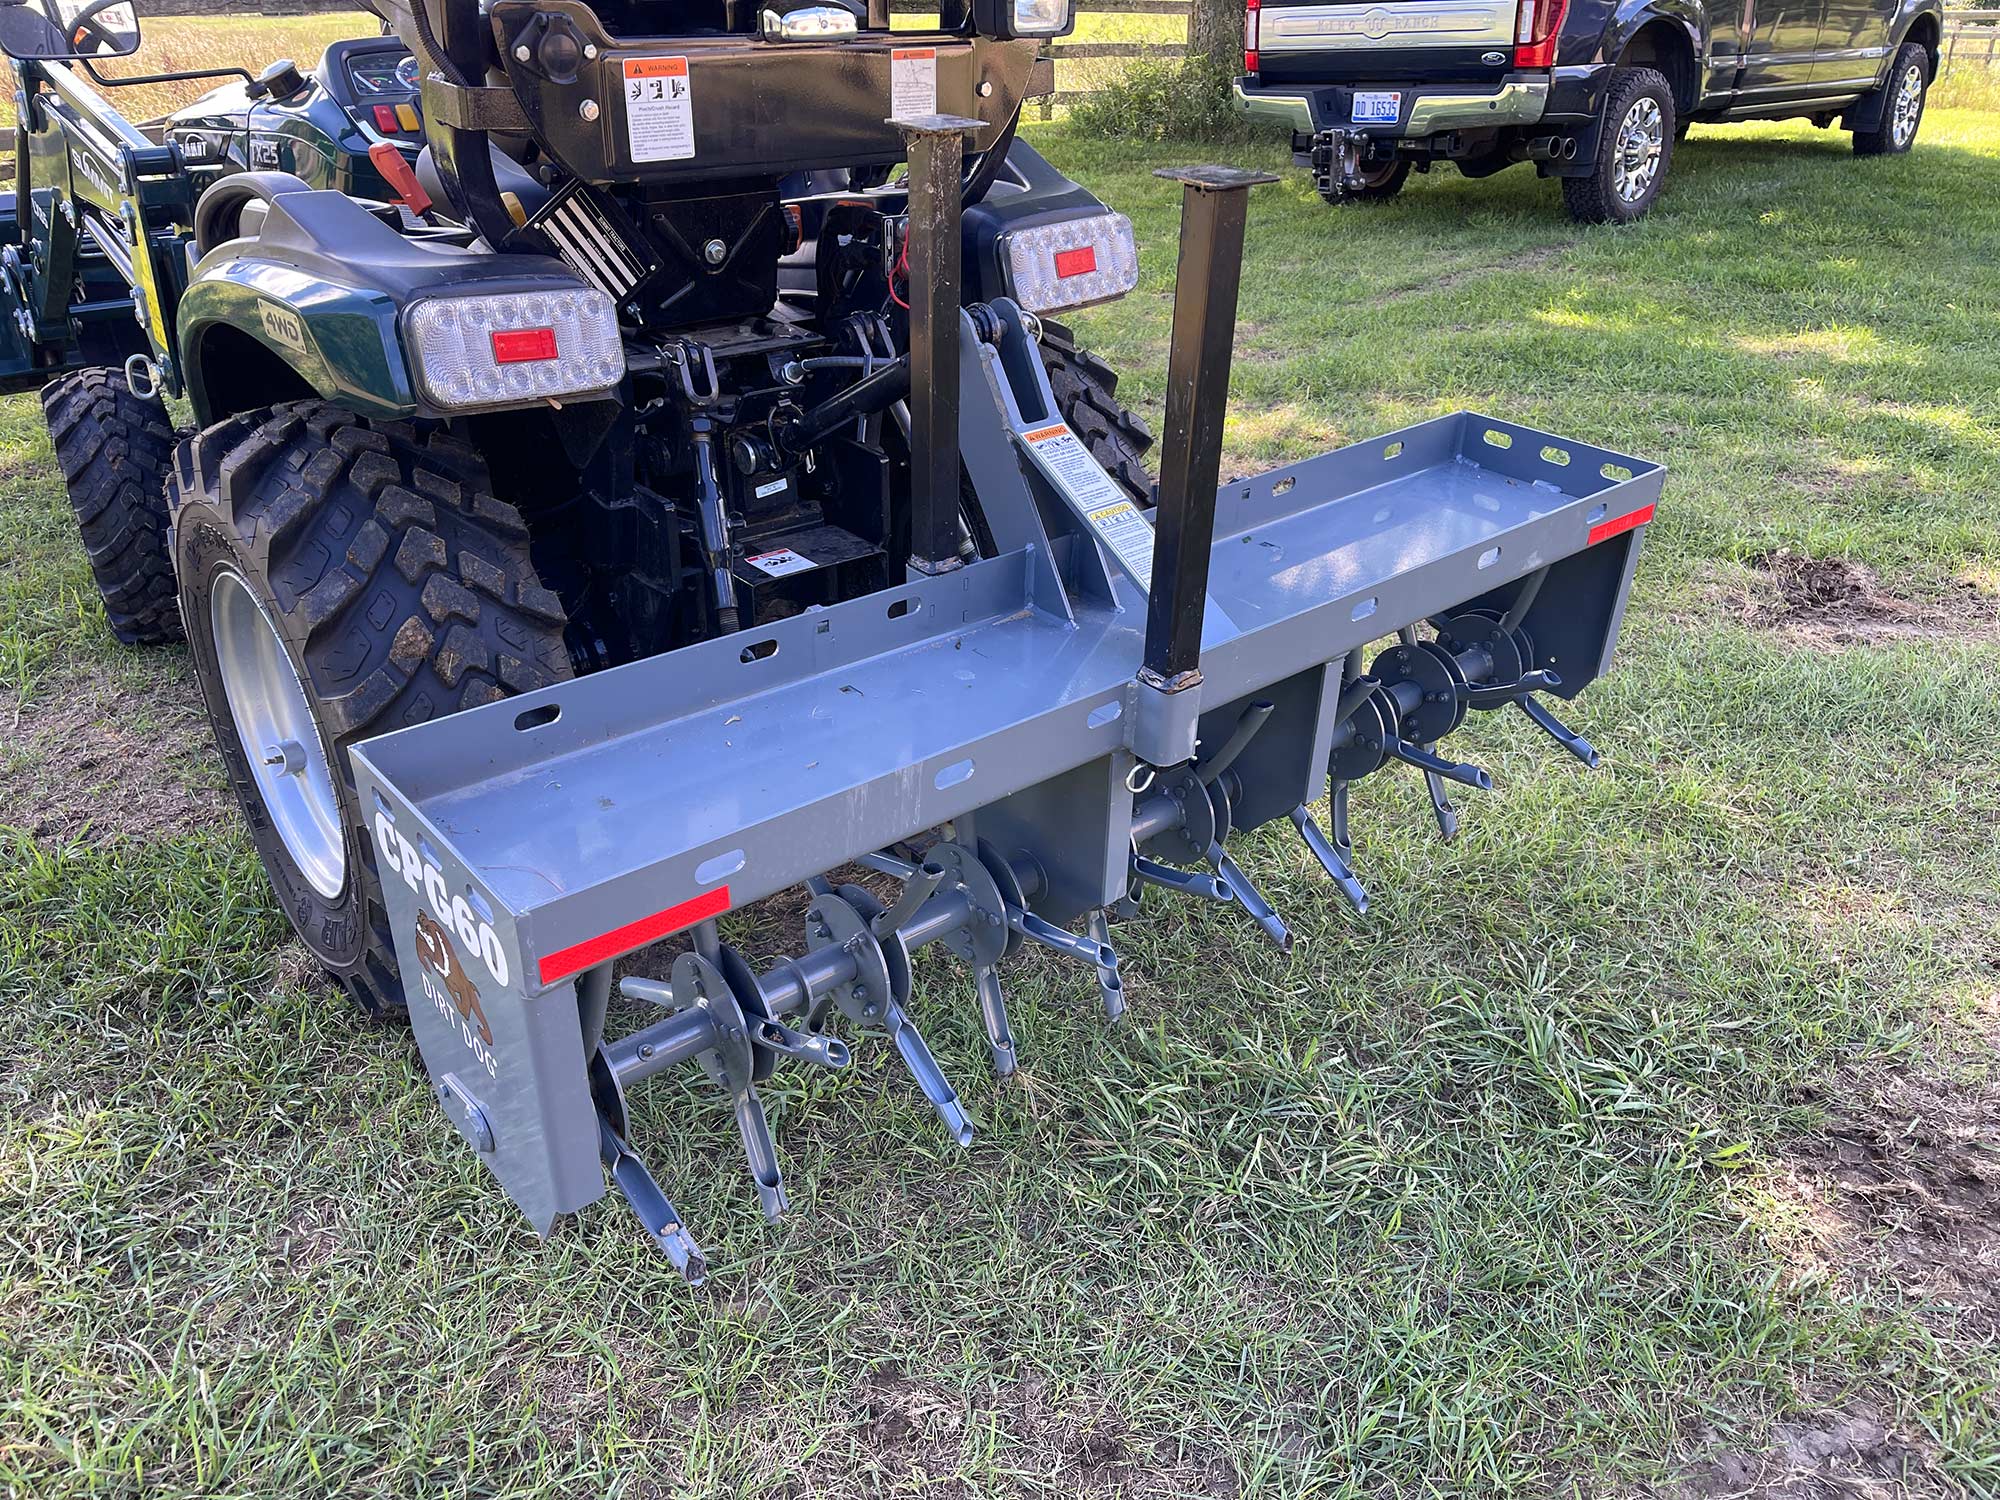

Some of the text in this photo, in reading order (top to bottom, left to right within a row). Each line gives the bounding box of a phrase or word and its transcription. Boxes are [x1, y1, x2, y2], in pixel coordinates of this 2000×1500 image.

[1317, 16, 1439, 32] KING RANCH
[647, 64, 678, 72] WARNING
[1371, 101, 1397, 116] 16535
[250, 143, 279, 165] TX25
[71, 148, 114, 206] SUMMIT
[266, 312, 299, 341] 4WD
[1034, 426, 1067, 438] WARNING
[1100, 503, 1129, 517] CAUTION
[375, 811, 509, 987] CPG60
[421, 971, 497, 1080] DIRT DOG
